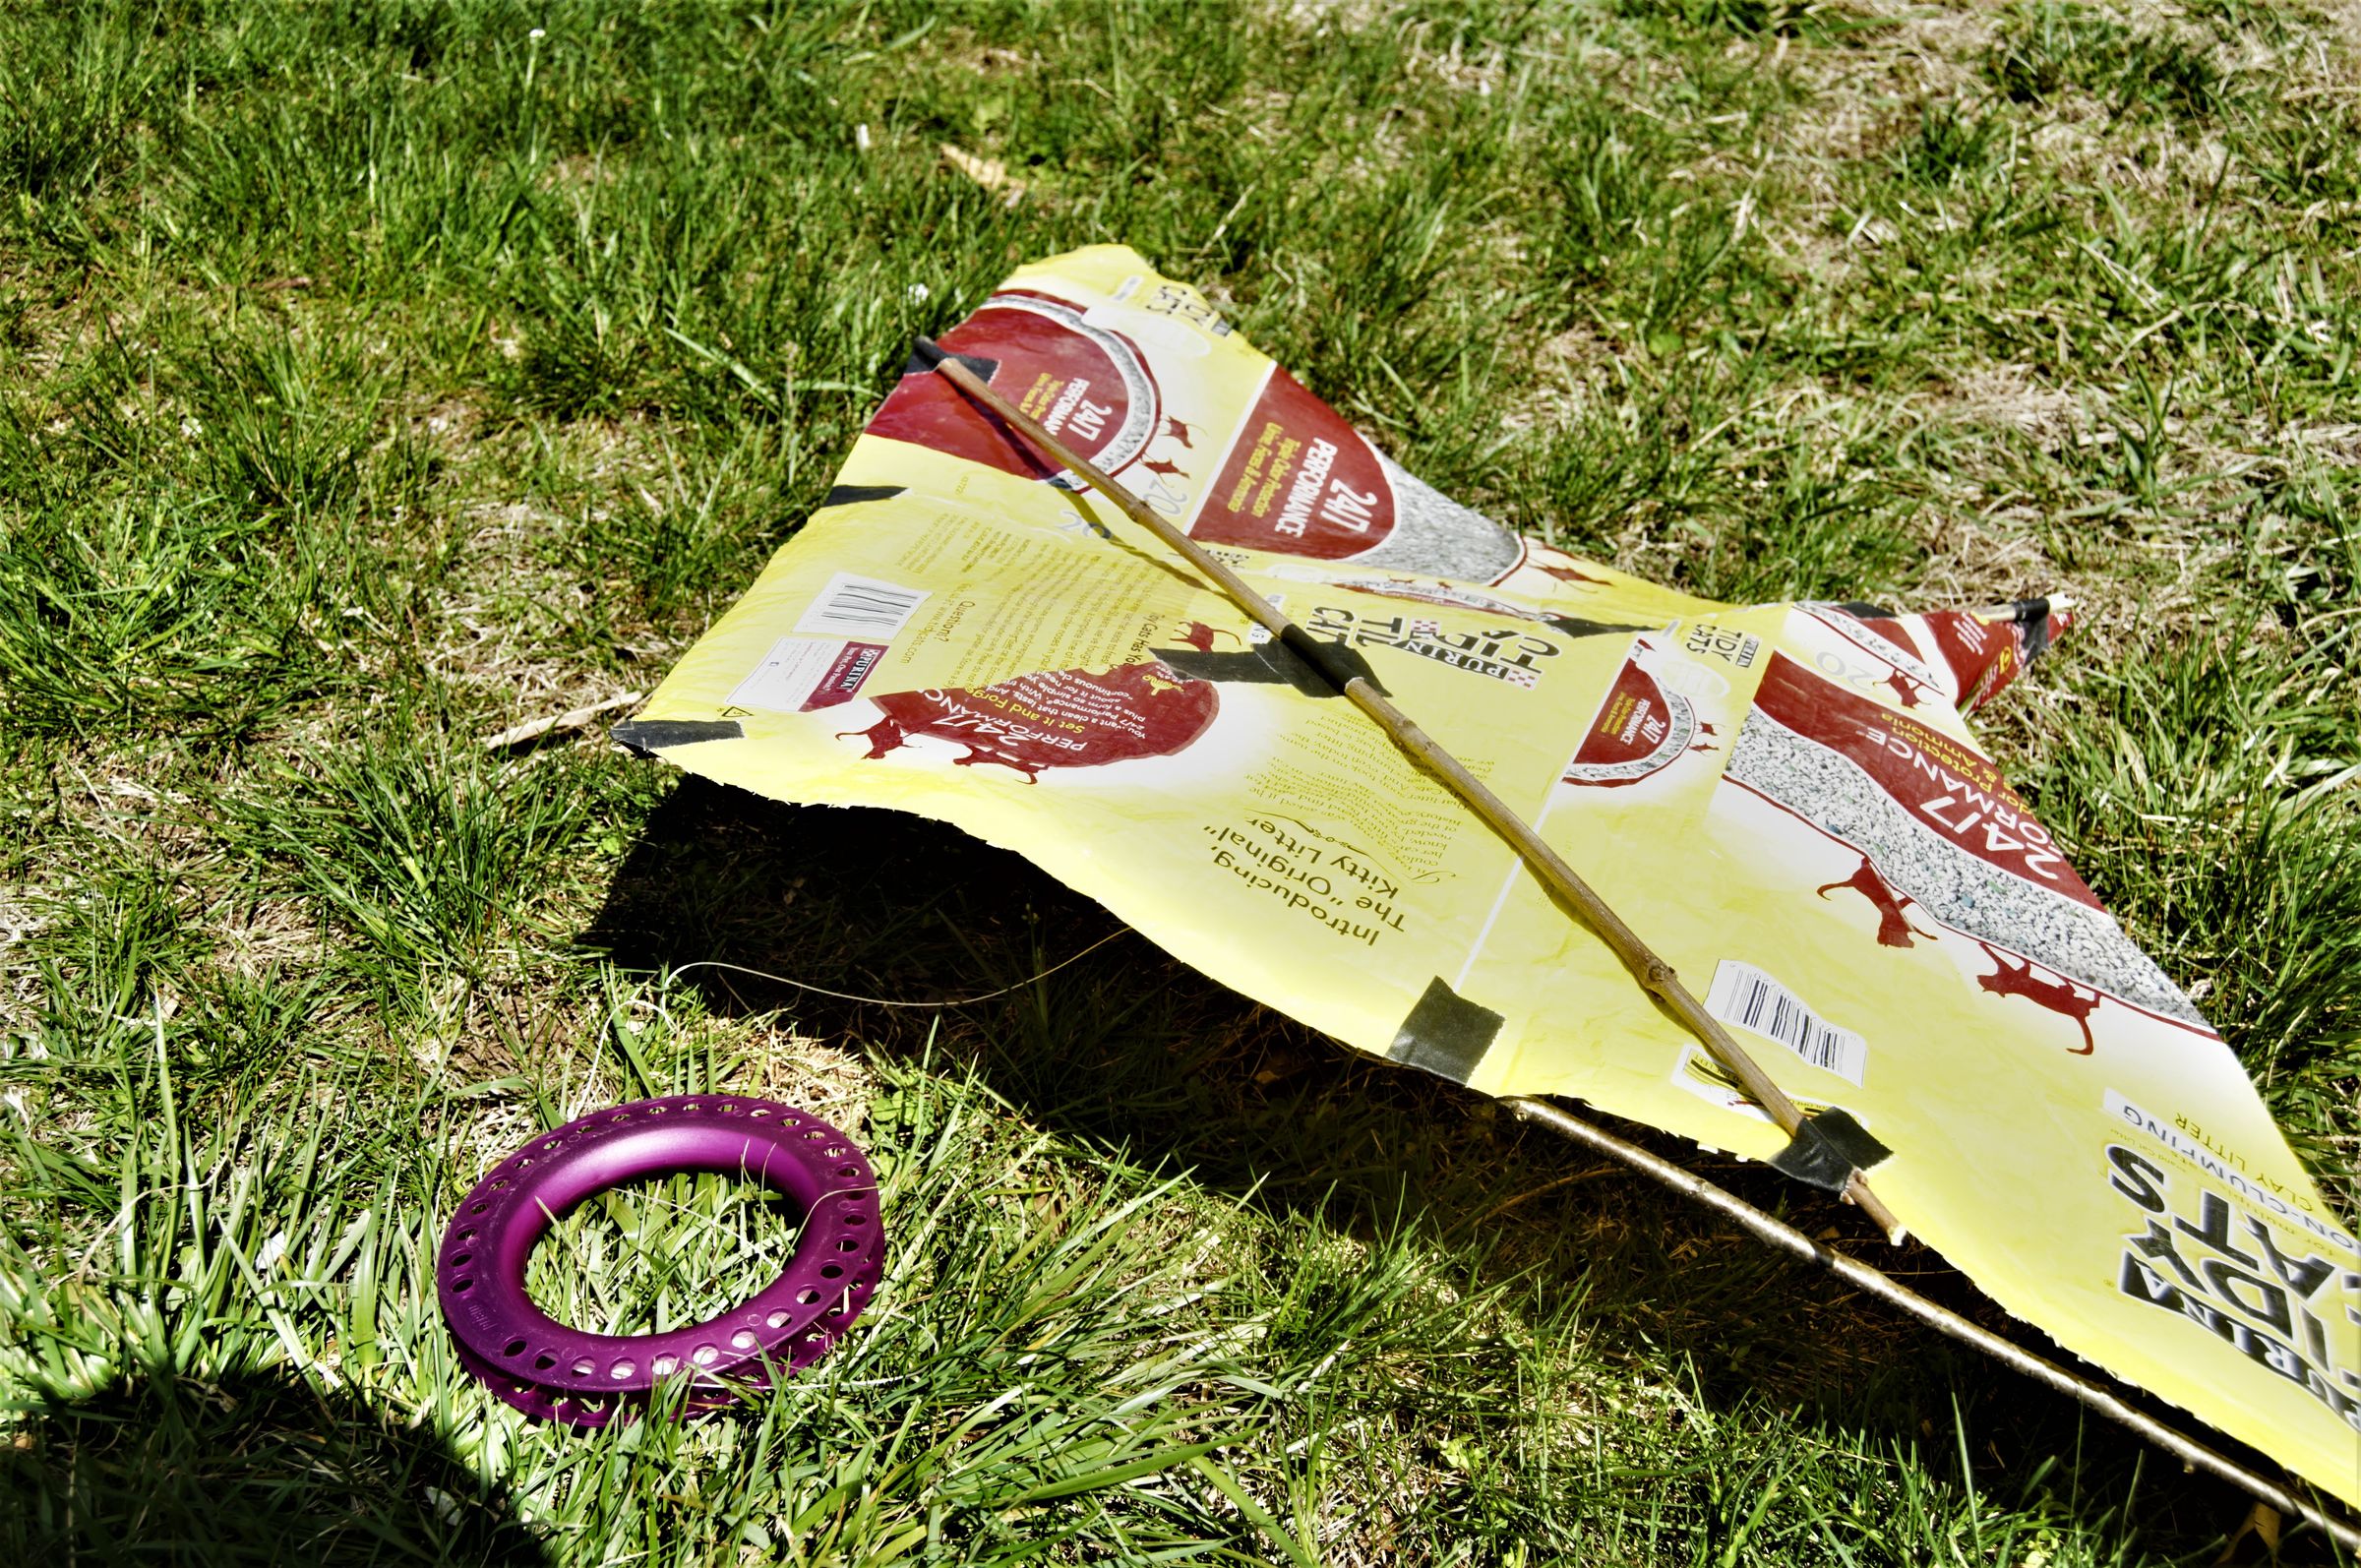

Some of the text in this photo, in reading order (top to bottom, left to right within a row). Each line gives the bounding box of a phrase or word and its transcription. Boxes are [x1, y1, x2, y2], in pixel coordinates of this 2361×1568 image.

[1041, 377, 1089, 437] PERFORMAN
[1066, 398, 1112, 442] 24/7
[1226, 473, 1257, 513] Ammonia
[1250, 437, 1301, 518] Triple Odor Protection
[1273, 437, 1338, 537] PERFORMANCE
[1318, 478, 1378, 534] 24/7
[933, 600, 975, 642] Questions?
[1137, 622, 1158, 639] Cats
[1305, 608, 1354, 642] CAT
[1130, 637, 1149, 653] Has
[1432, 633, 1541, 673] TID
[1480, 631, 1558, 655] CA
[1686, 624, 1717, 653] CATS
[1710, 628, 1741, 661] TIDY
[834, 663, 845, 673] Our
[839, 656, 871, 688] PURINA
[1402, 639, 1503, 677] PURIN
[1815, 652, 1875, 693] 20
[1017, 683, 1041, 699] With
[1038, 682, 1069, 700] simple
[1057, 669, 1071, 682] cle
[1062, 683, 1077, 694] for
[963, 686, 1085, 733] Set It and Forge
[1012, 691, 1036, 707] lasts.
[1037, 703, 1059, 715] that
[1072, 695, 1086, 704] so
[1078, 689, 1088, 697] it
[1087, 698, 1110, 710] form
[1089, 692, 1120, 702] about
[917, 686, 1087, 751] PERFORMANC
[931, 712, 1029, 746] 24/7
[1060, 709, 1088, 723] clean
[1119, 717, 1144, 729] 24/7
[1122, 707, 1144, 722] plus
[1619, 697, 1651, 746] PERFORMANCE
[1640, 714, 1665, 744] 24/7
[1126, 726, 1145, 739] You
[1314, 730, 1342, 748] litter
[1881, 711, 1998, 783] & Ammonia
[1893, 724, 1992, 792] Protection
[1865, 724, 2060, 855] ORMANCE
[1918, 796, 2060, 877] 24/7
[1245, 816, 1398, 899] Kitty Litter
[1210, 847, 1379, 946] Introducing,
[1354, 894, 1405, 932] The
[2118, 1103, 2361, 1249] ON-CLUMPING
[2173, 1112, 2314, 1213] CLAY LITTER
[2130, 1217, 2361, 1390] IDY
